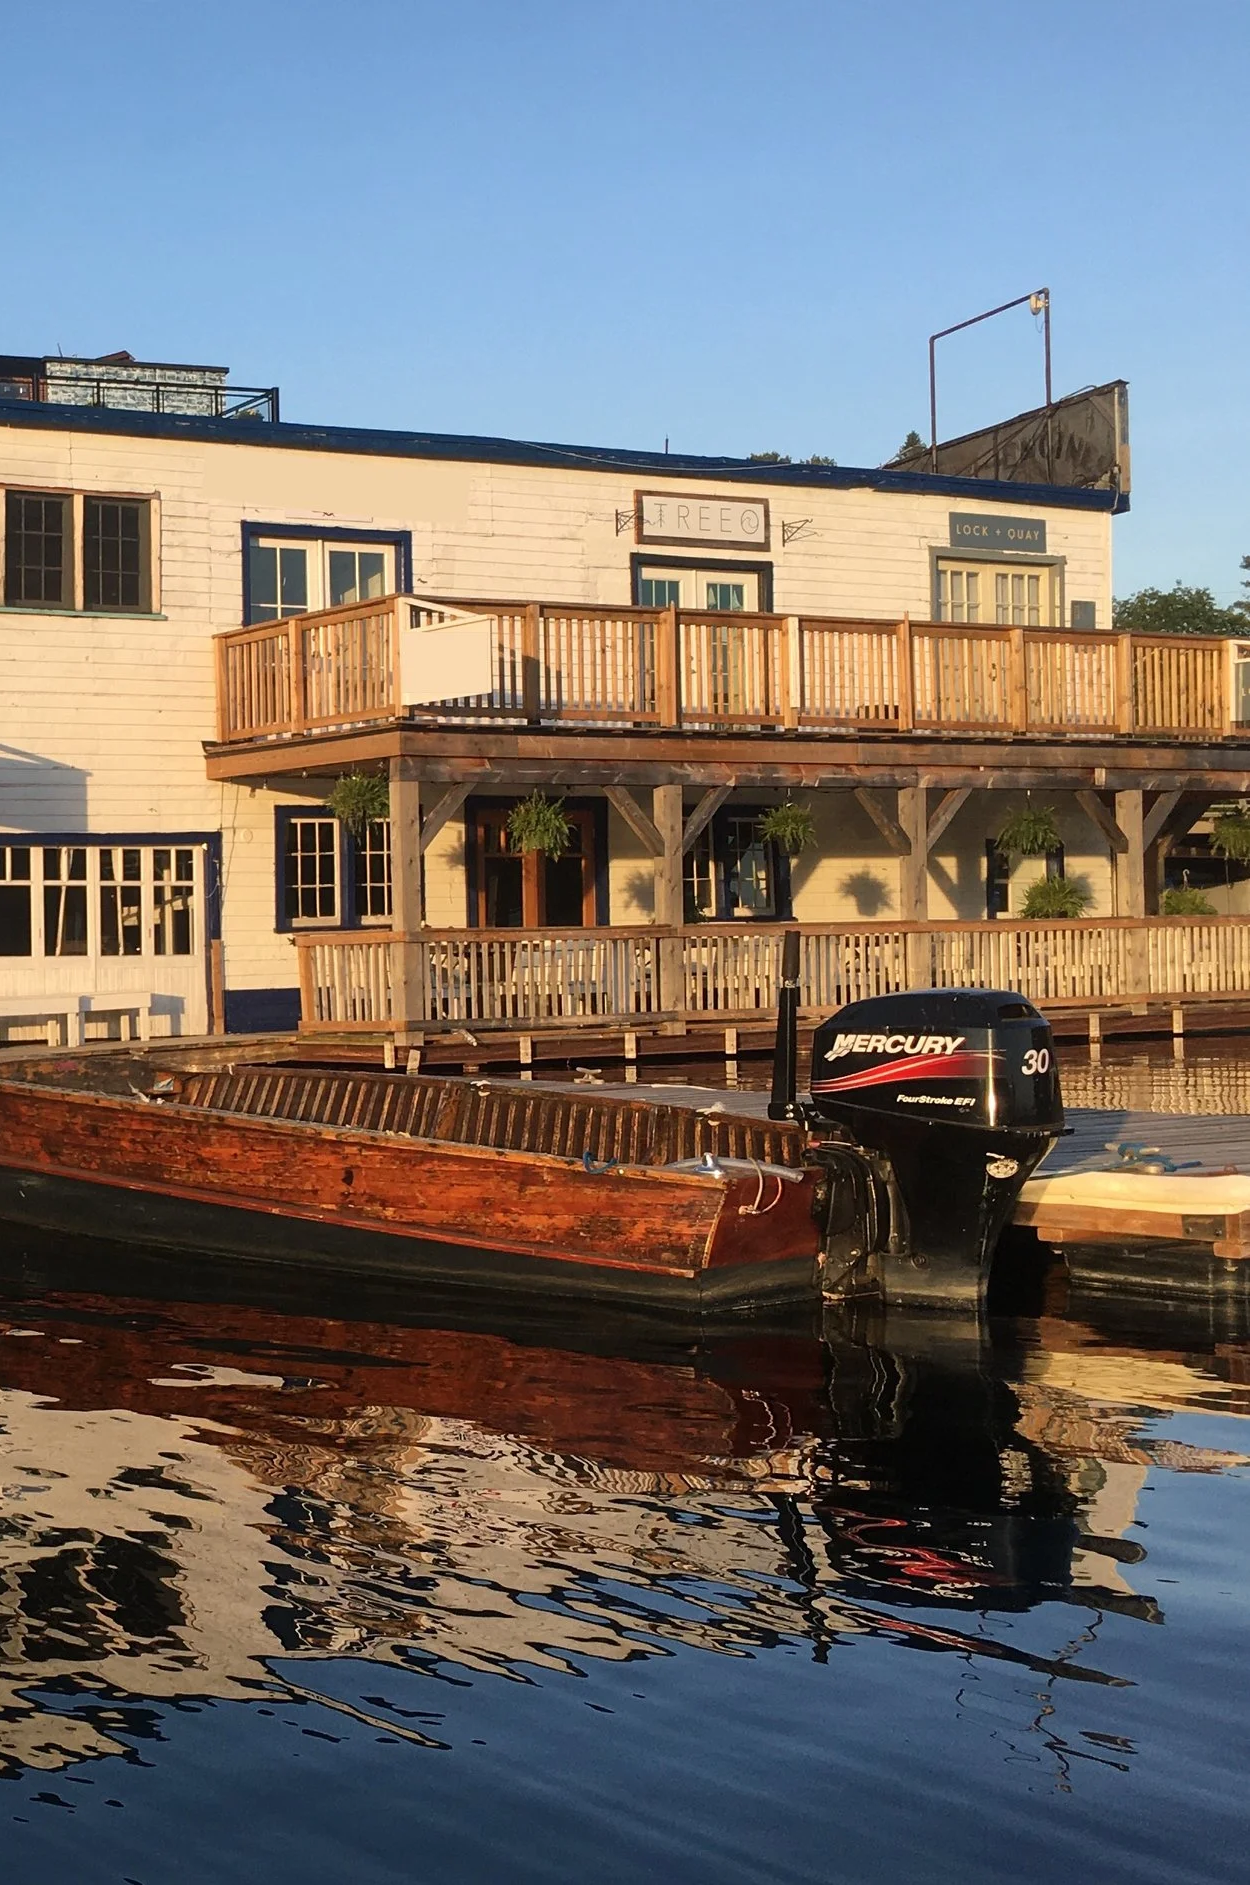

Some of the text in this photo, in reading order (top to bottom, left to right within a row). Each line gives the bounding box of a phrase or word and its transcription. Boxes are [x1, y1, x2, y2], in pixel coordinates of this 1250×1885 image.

[956, 523, 1040, 541] LOCK + QUAY
[823, 1033, 966, 1062] MERCURY
[1021, 1048, 1050, 1076] 30
[896, 1094, 976, 1107] FourStroke EFI
